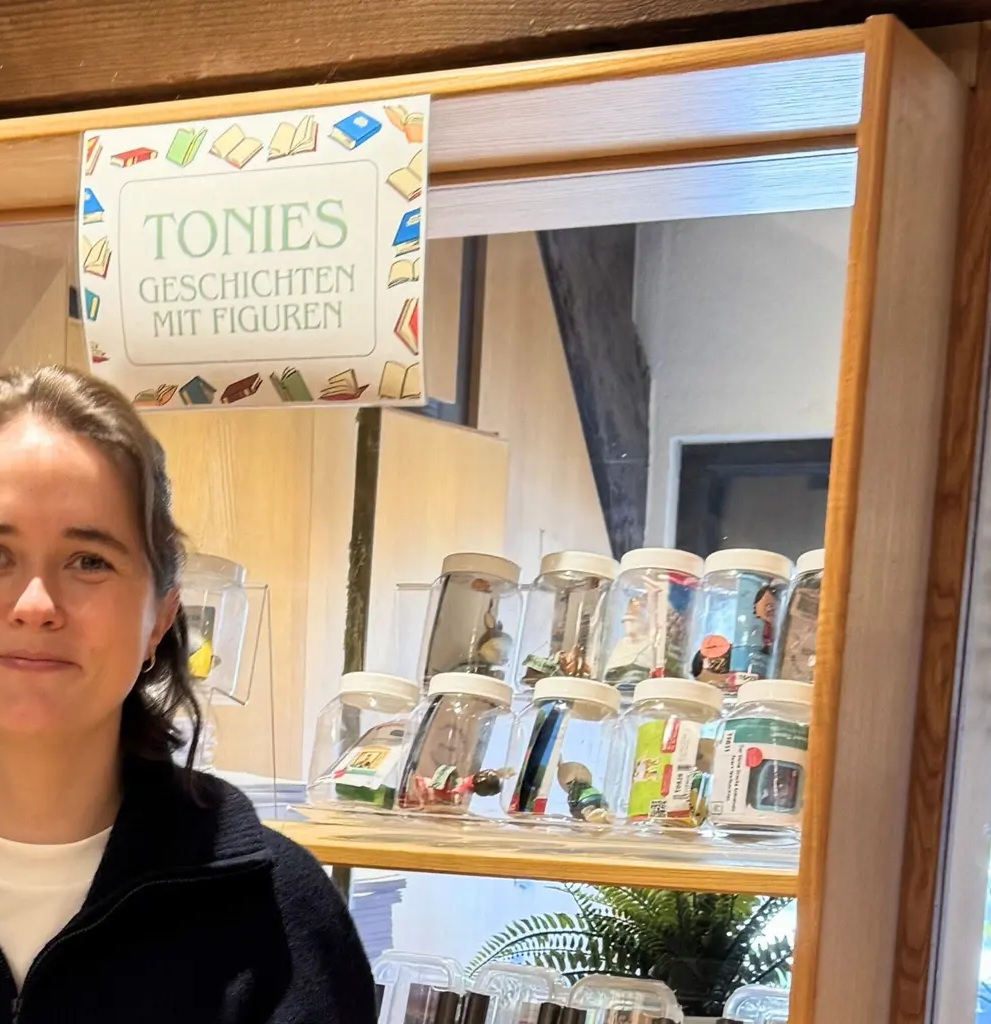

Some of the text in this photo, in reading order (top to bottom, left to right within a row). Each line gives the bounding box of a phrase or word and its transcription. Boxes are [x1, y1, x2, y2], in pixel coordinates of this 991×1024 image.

[143, 198, 349, 261] TONIES
[139, 264, 355, 304] GESCHICHTEN
[153, 301, 343, 338] MIT FIGUREN
